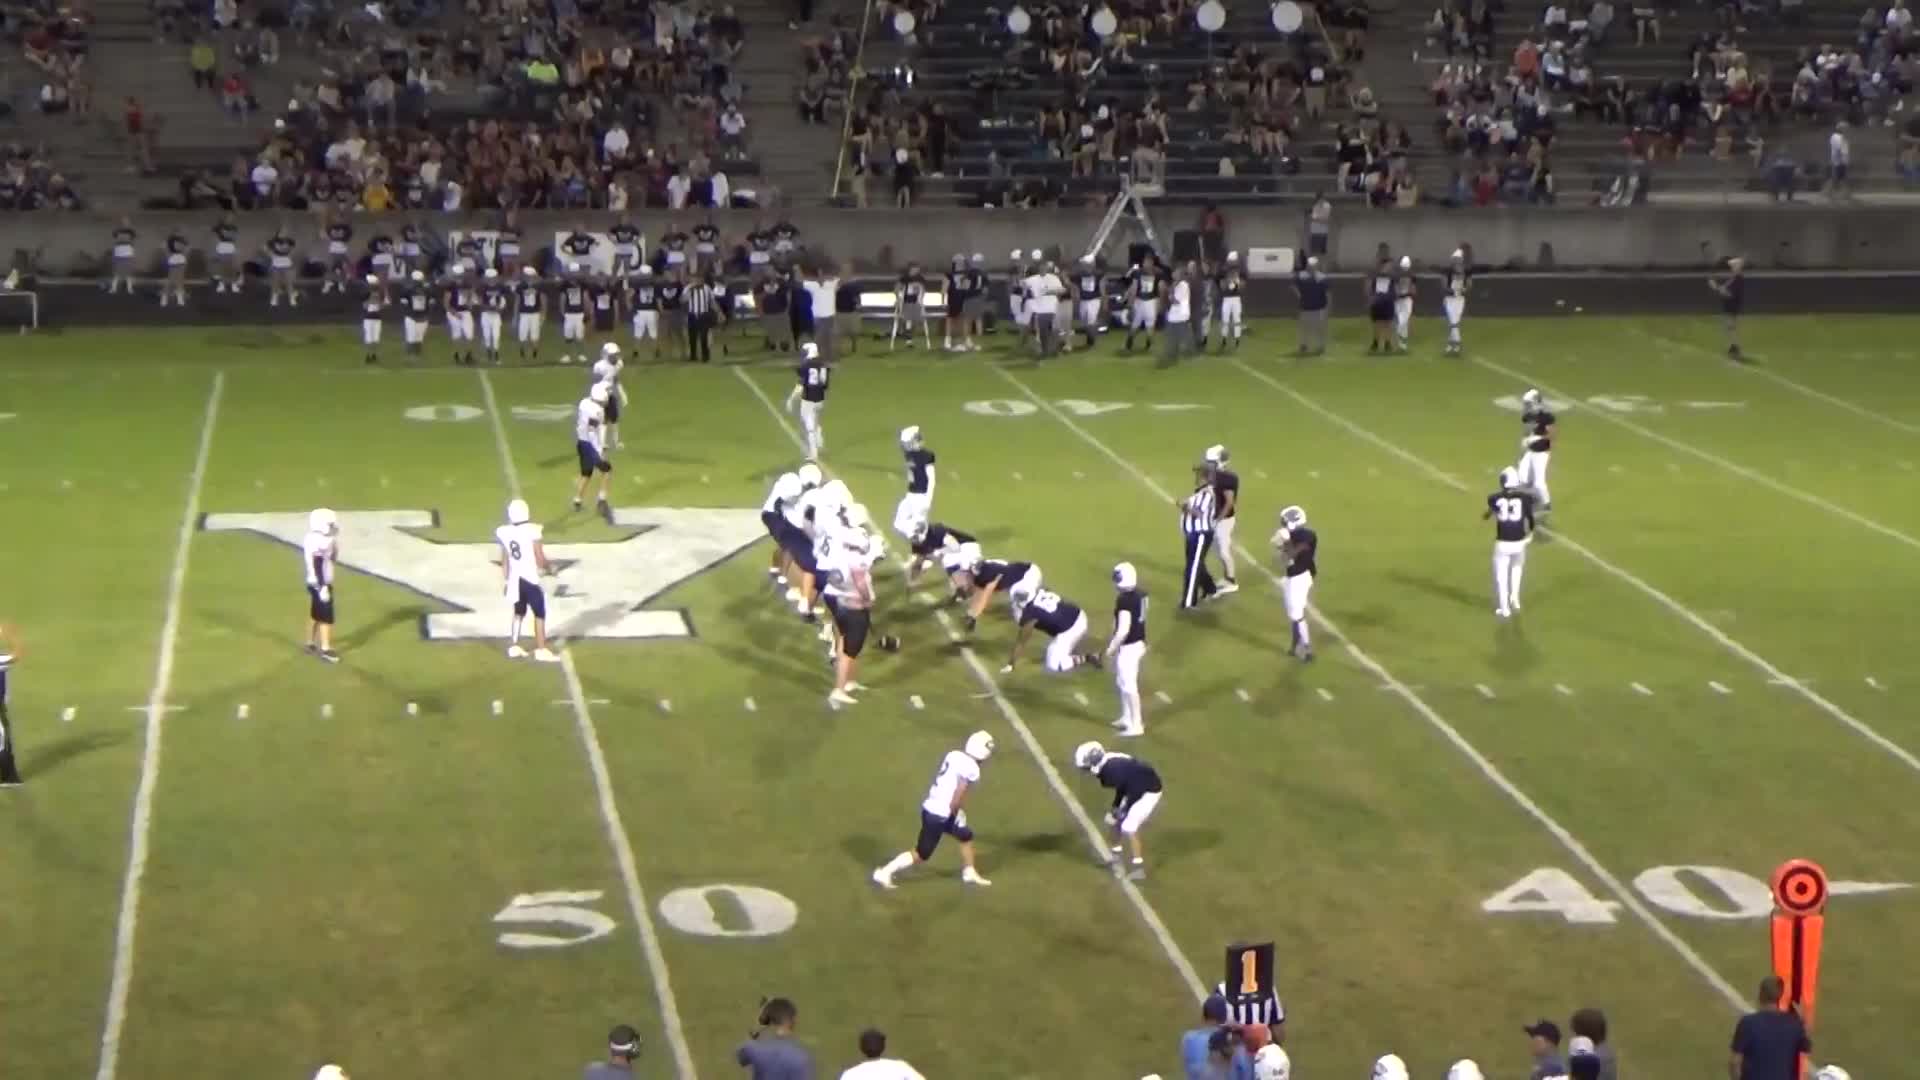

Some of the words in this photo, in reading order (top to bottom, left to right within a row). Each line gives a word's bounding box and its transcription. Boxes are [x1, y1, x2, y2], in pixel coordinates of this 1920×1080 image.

[1496, 498, 1522, 521] 33
[510, 540, 521, 560] 8
[494, 884, 798, 947] 50
[1482, 865, 1775, 923] 40
[1241, 950, 1258, 993] 1
